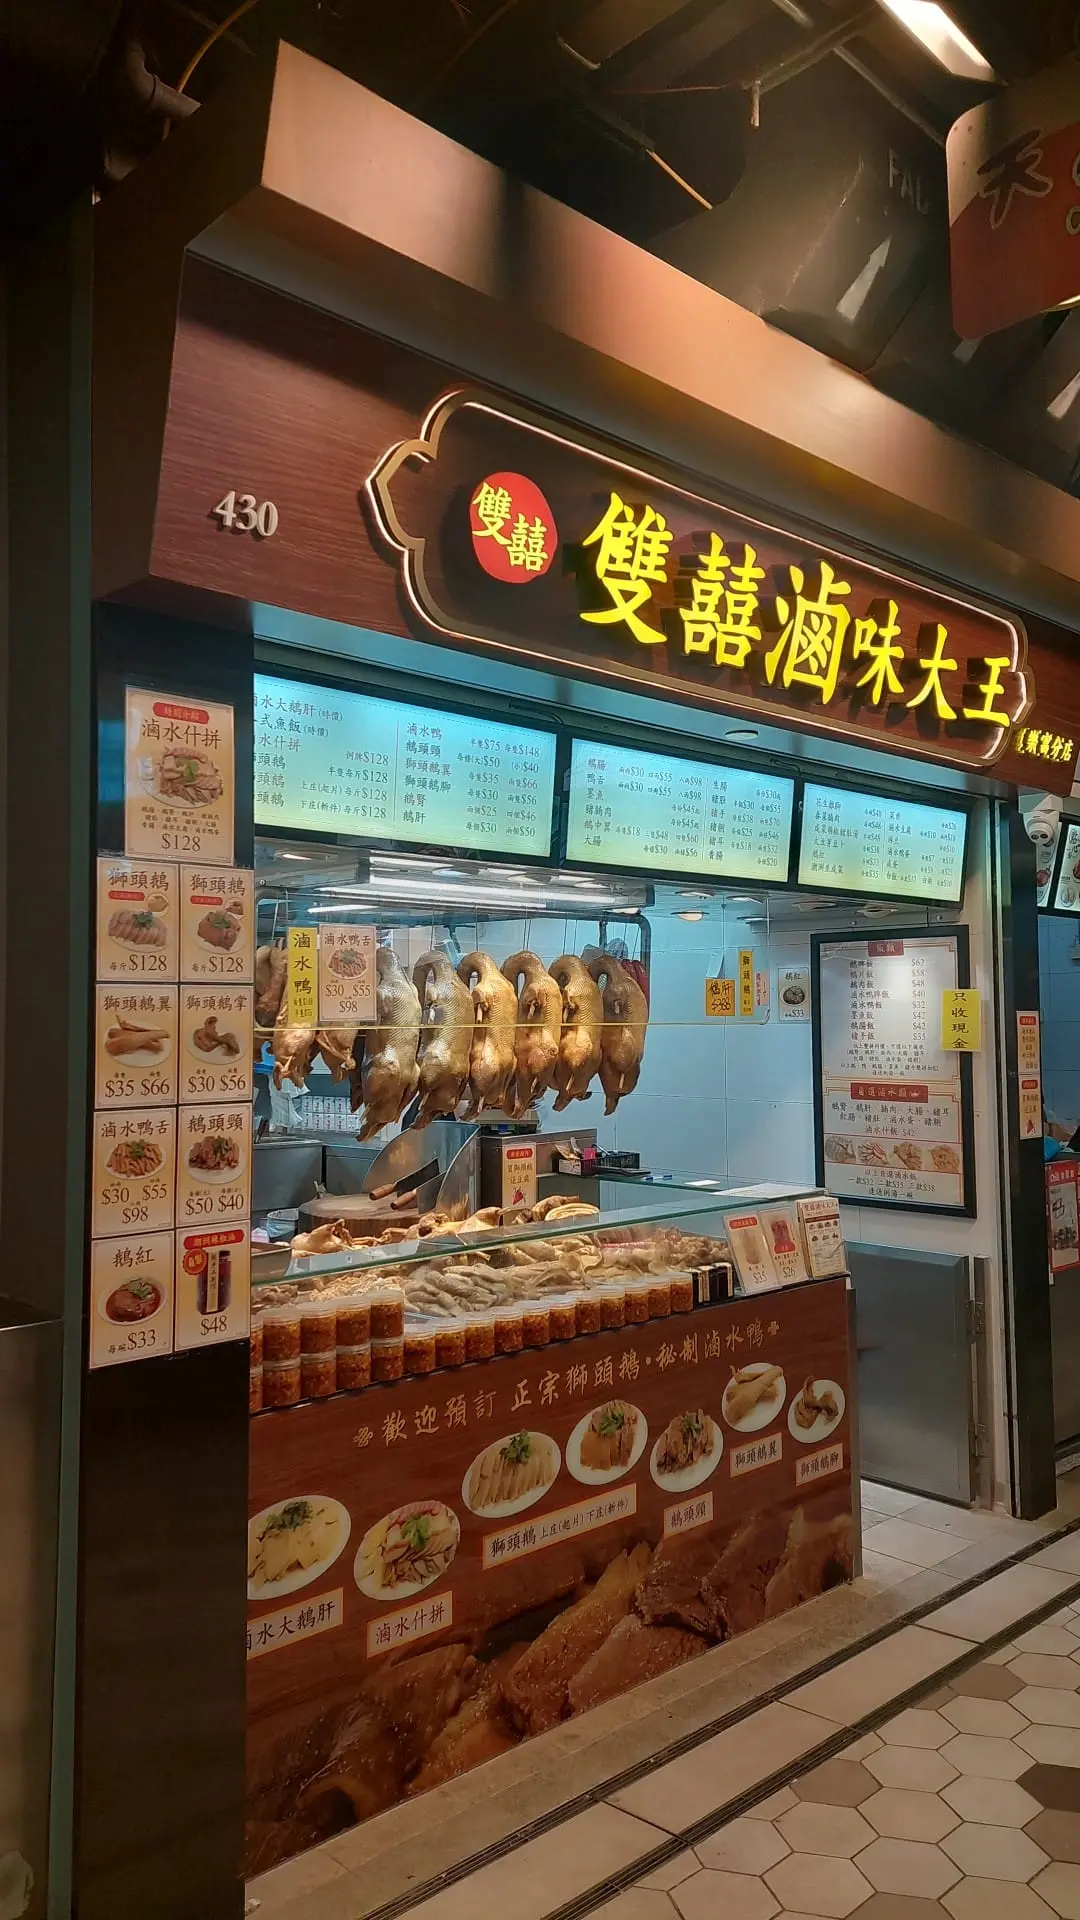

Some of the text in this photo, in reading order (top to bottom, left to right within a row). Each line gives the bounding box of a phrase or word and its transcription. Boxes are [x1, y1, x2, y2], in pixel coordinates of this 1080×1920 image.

[213, 490, 279, 537] 430
[471, 482, 549, 572] 雙囍
[579, 491, 1012, 727] 雙囍滷味大王
[142, 719, 221, 749] 滷水什拼
[253, 713, 302, 734] 式魚飯
[407, 722, 442, 740] 滷水鴨
[253, 733, 300, 752] 水什拼
[254, 752, 286, 769] 頭鵝
[254, 772, 285, 788] 頭鵝
[254, 791, 284, 807] 頭鵝
[161, 833, 201, 851] $128
[108, 868, 169, 892] 獅頭鵝
[190, 874, 245, 896] 獅頭鵝
[324, 933, 371, 947] 滷水鴨舌
[293, 932, 312, 994] 滷水鴨
[325, 984, 371, 997] $30 $55
[104, 996, 172, 1012] 獅頭鵝翼
[186, 995, 247, 1012] 獅頭鵝掌
[339, 1000, 358, 1013] $98
[951, 992, 969, 1049] 只收現金
[105, 1077, 170, 1098] $35 $66
[187, 1074, 246, 1094] $30 $56
[101, 1119, 170, 1138] 滷水鴨舌
[188, 1113, 244, 1134] 鵝頭頸
[101, 1185, 167, 1206] $30 $55
[185, 1194, 244, 1216] $50 $40
[122, 1206, 149, 1224] $98
[112, 1247, 155, 1269] 鵝紅
[200, 1315, 227, 1336] $48
[382, 1389, 498, 1448] 歡迎預訂
[734, 1442, 778, 1469] 獅頭鵝翼
[800, 1454, 840, 1478] 獅頭鵝腳
[670, 1502, 707, 1530] 鵝頭頸
[490, 1528, 536, 1558] 獅頭鵝
[376, 1601, 446, 1645] 滷水什拼
